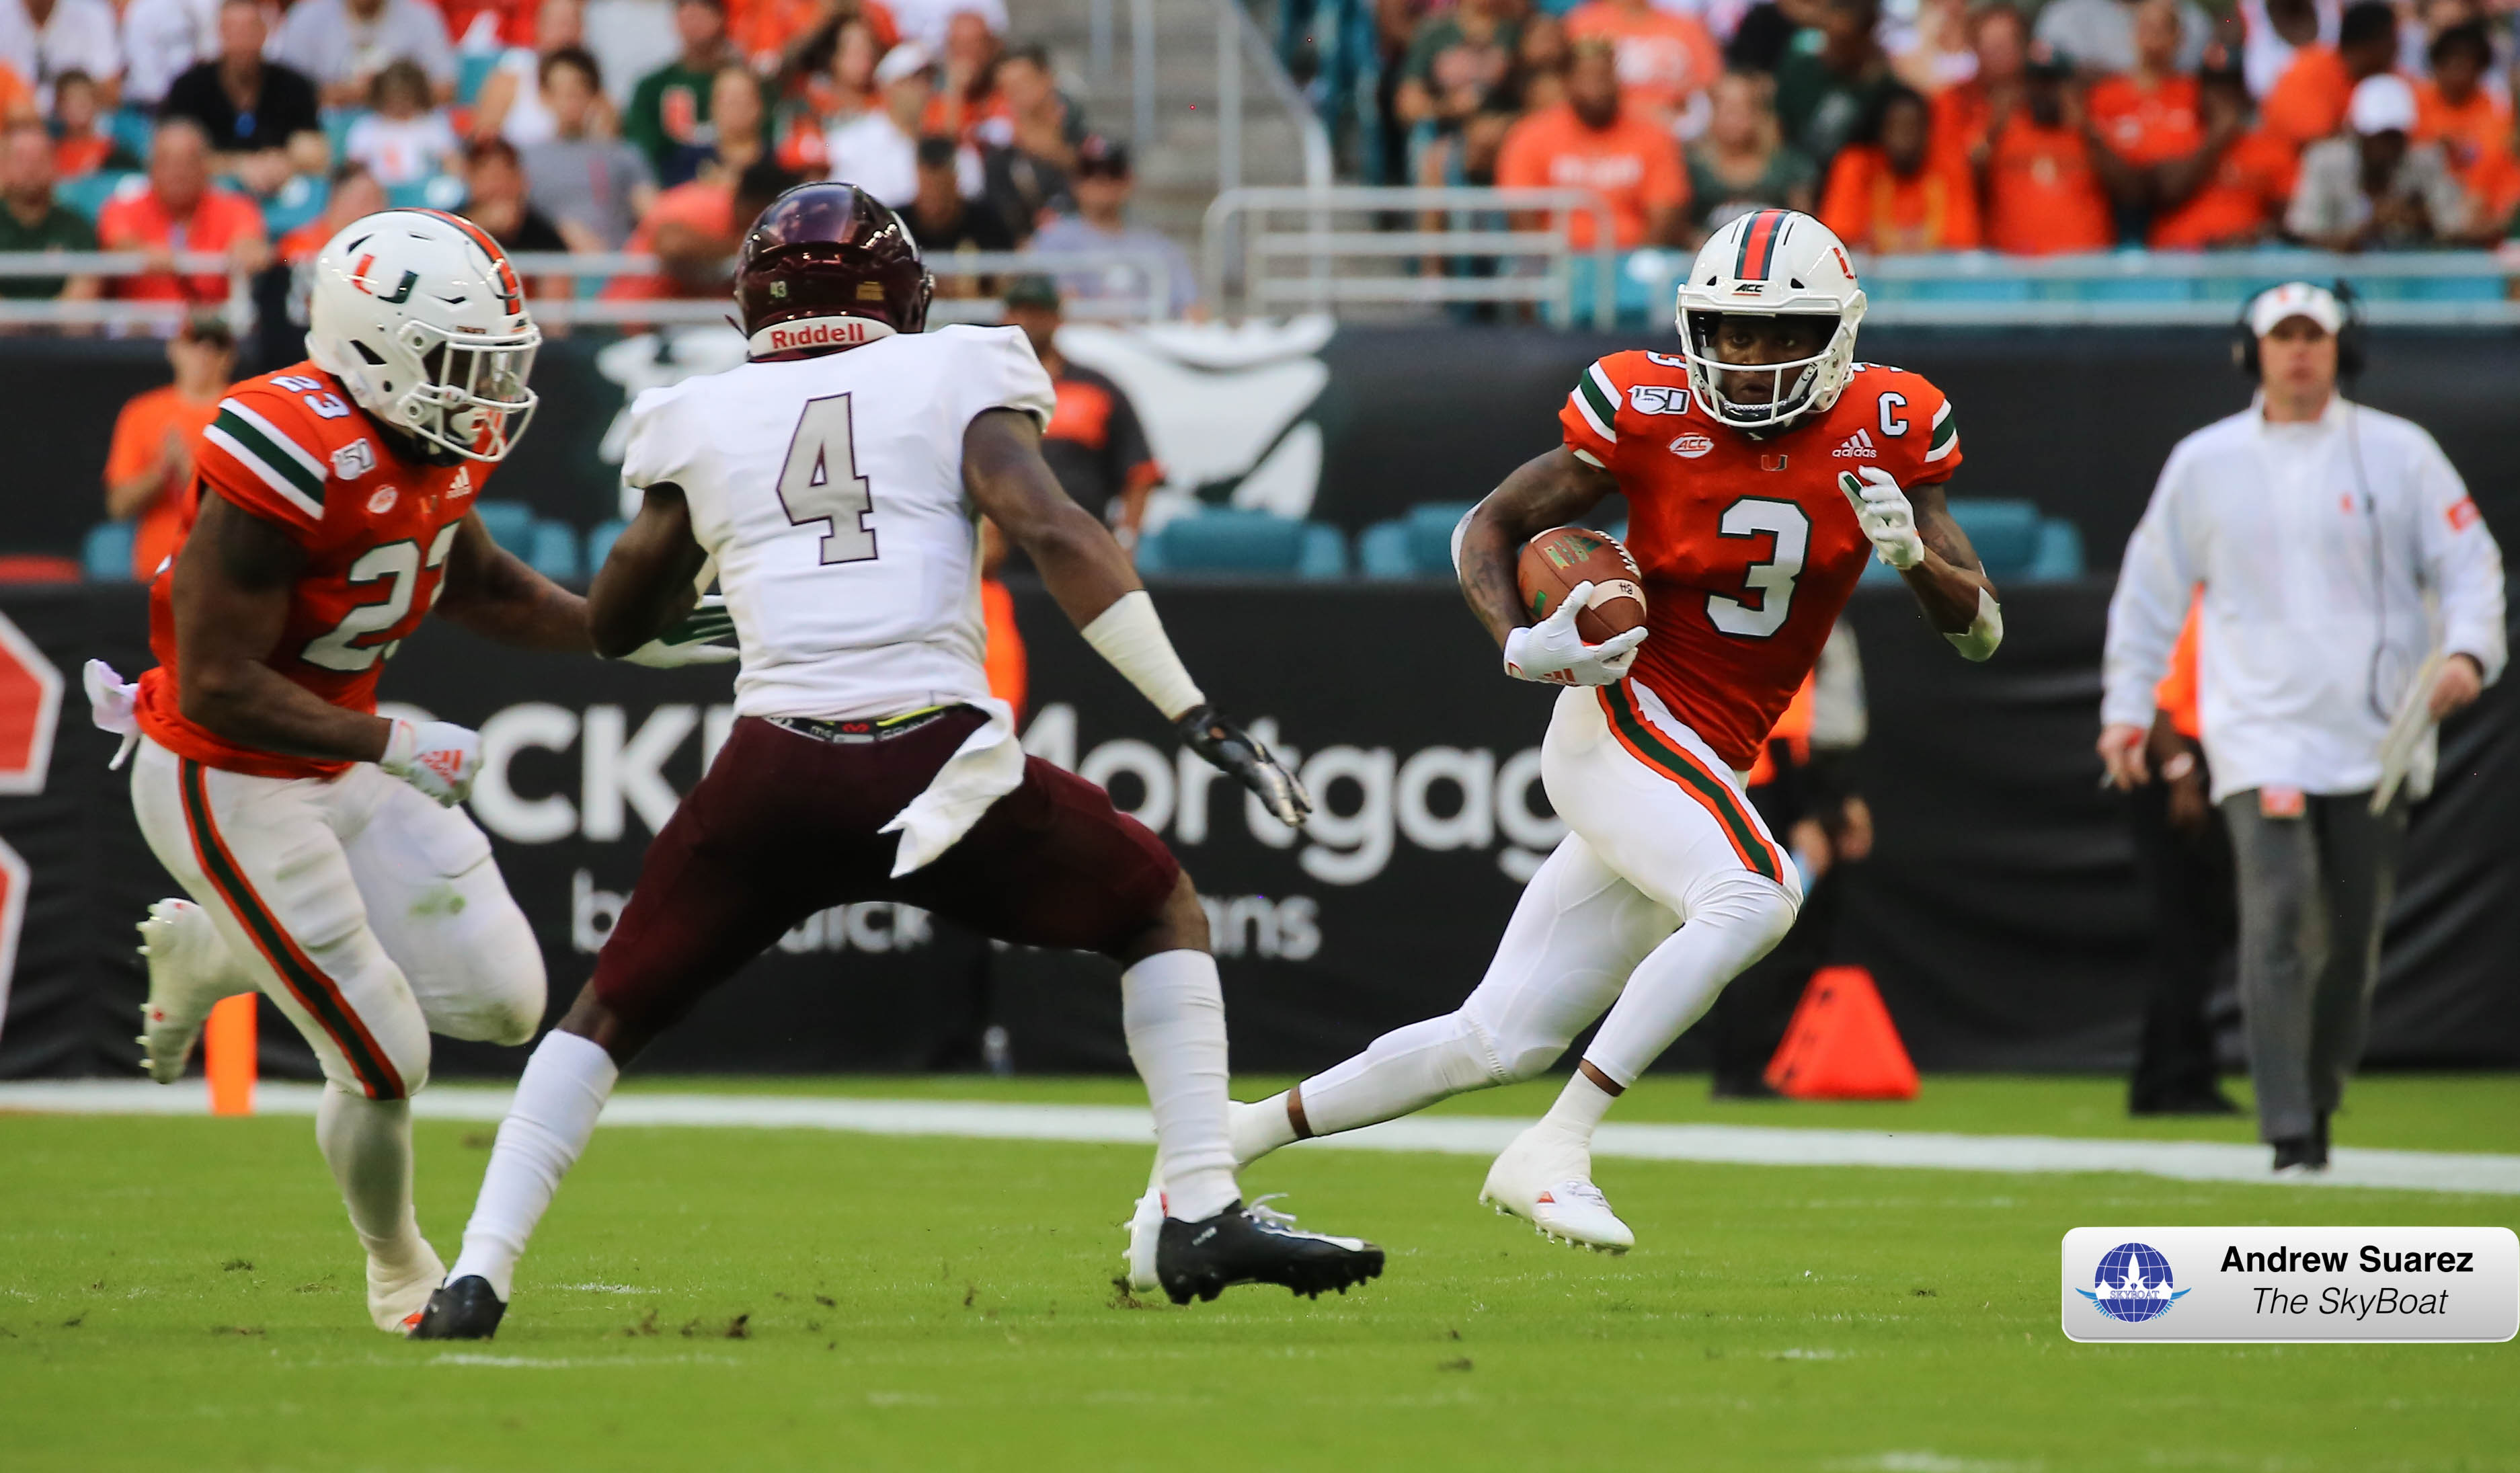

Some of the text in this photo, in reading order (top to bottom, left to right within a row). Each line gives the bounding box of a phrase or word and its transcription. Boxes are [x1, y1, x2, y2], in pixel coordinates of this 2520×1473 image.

[1734, 283, 1765, 293] ACC
[771, 323, 865, 349] Riddell
[268, 375, 351, 420] 23
[1878, 391, 1909, 437] C
[1832, 446, 1877, 458] adidas
[776, 391, 879, 565] 4
[1705, 495, 1812, 639] 3
